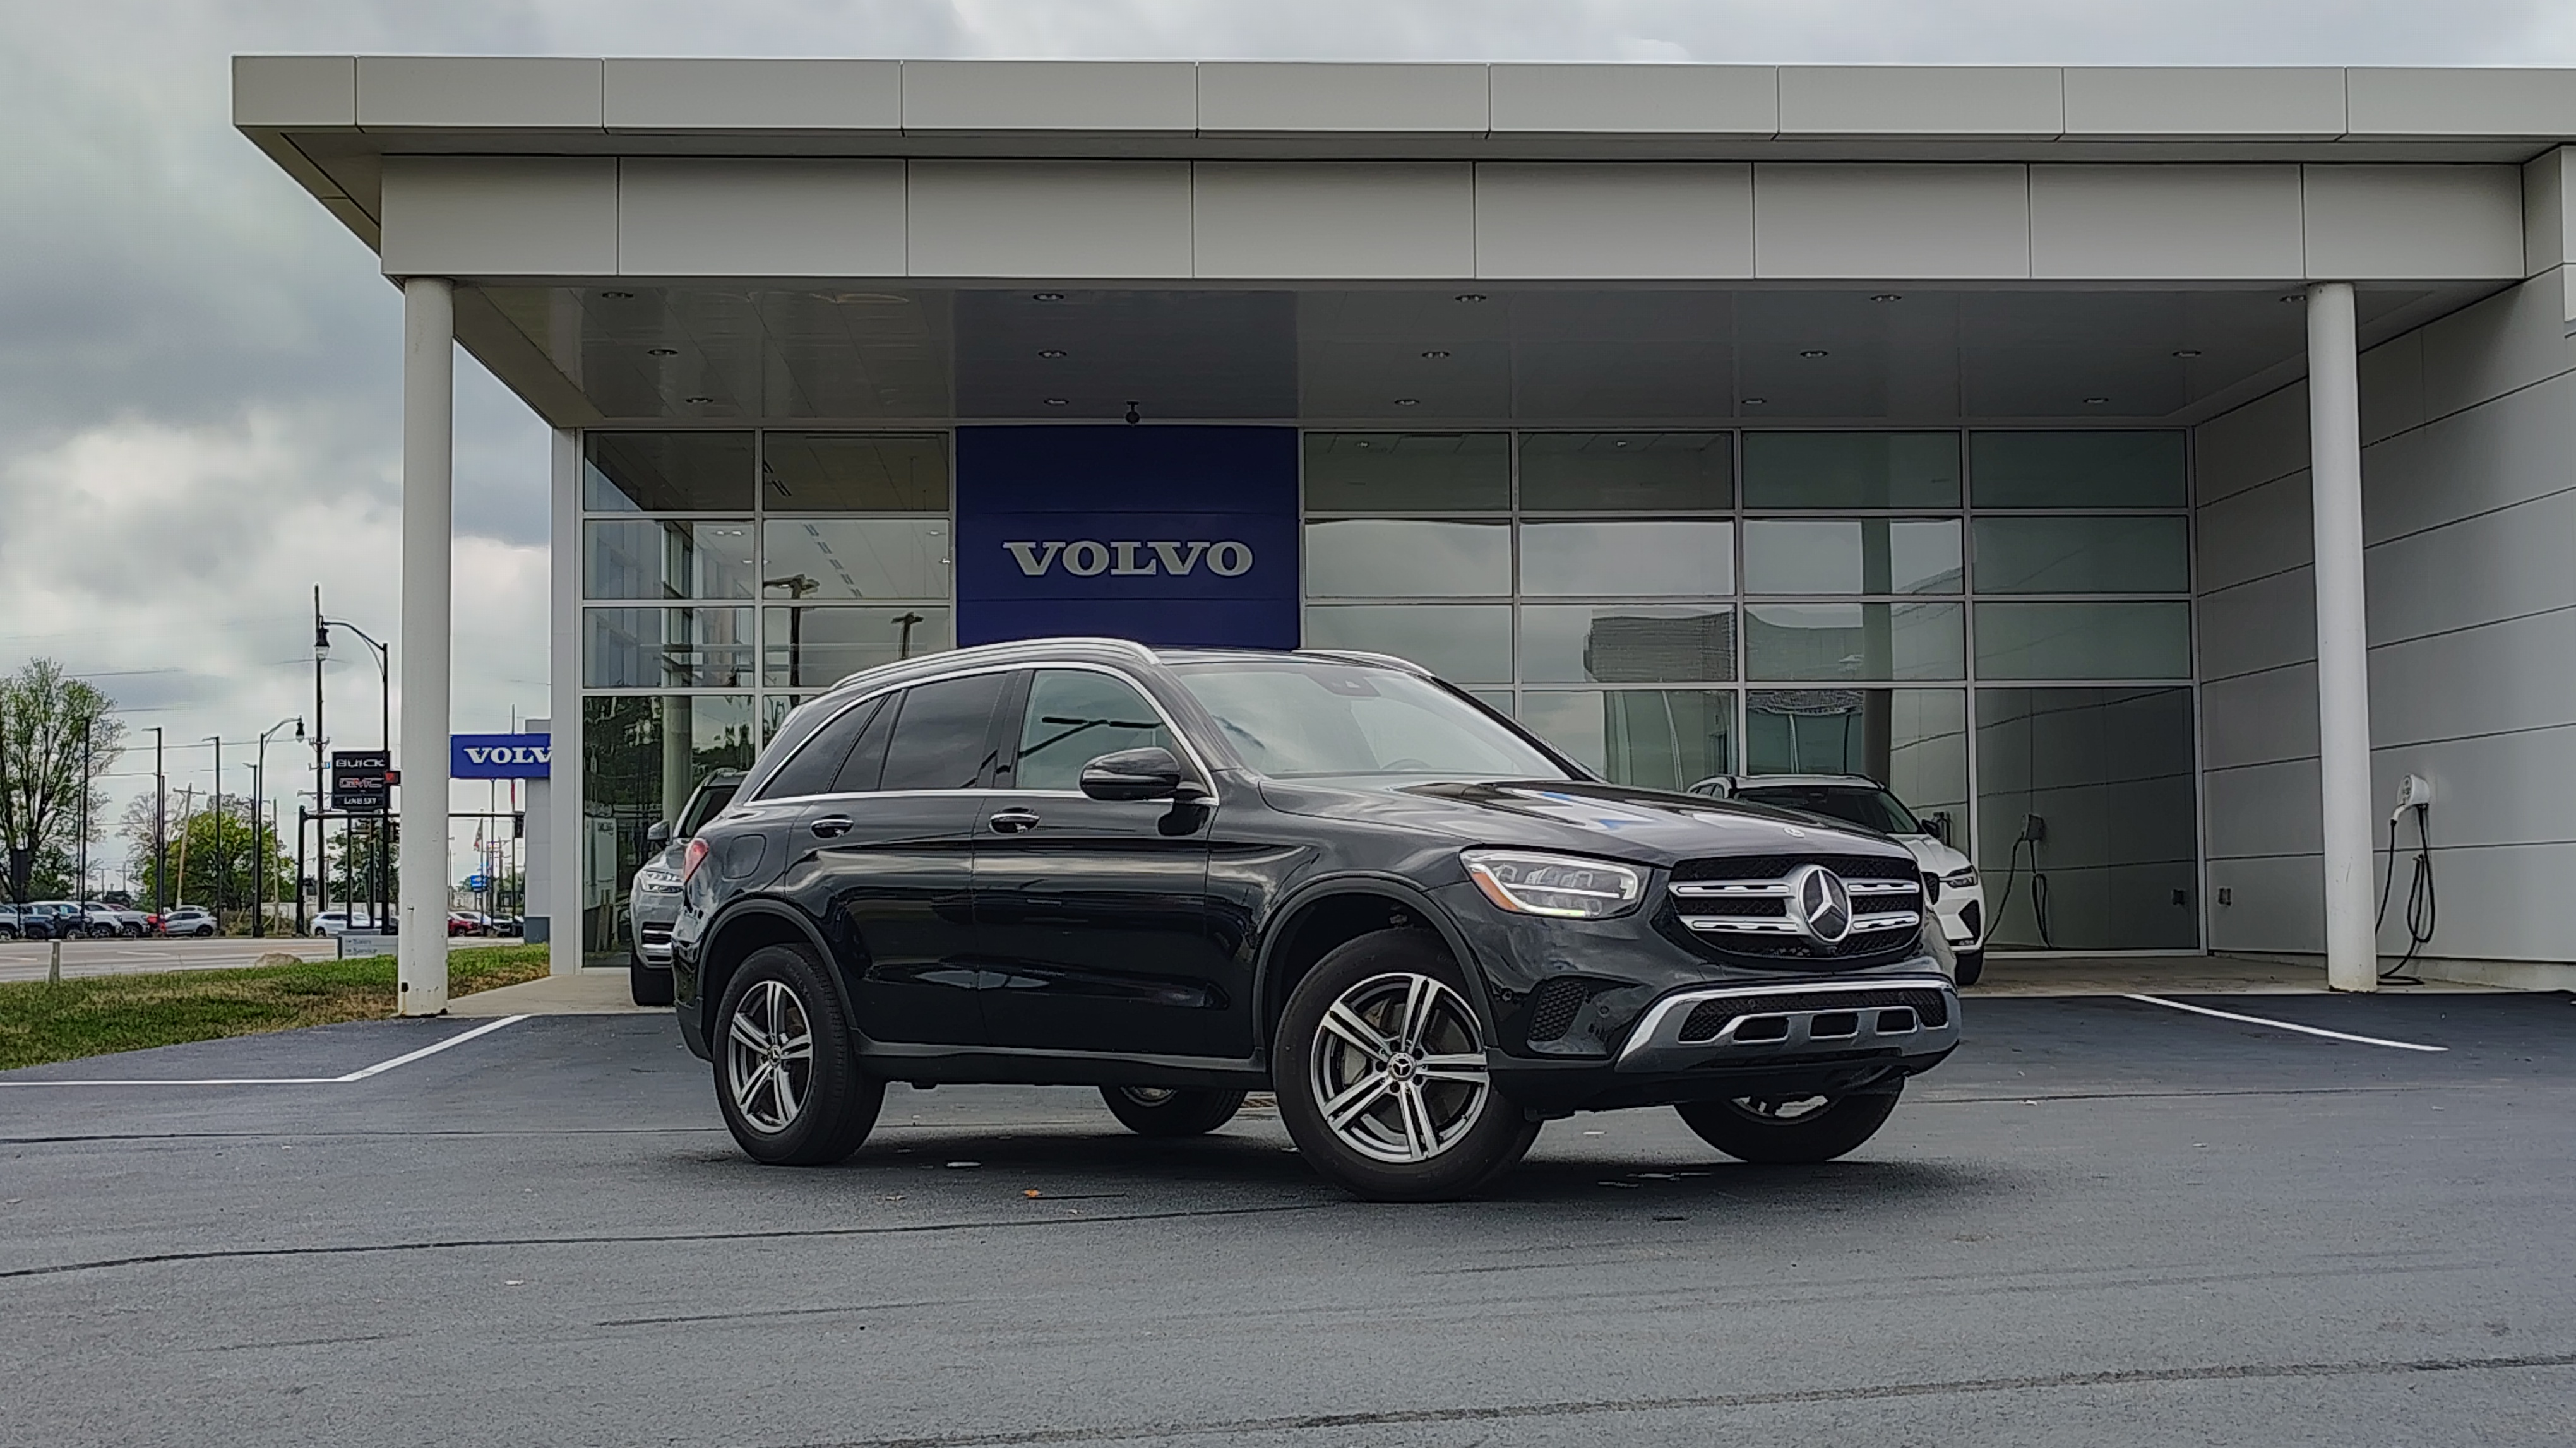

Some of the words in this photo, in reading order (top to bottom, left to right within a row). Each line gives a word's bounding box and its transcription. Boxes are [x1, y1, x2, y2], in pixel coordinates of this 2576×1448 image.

[1003, 540, 1253, 577] VOLVO
[463, 747, 552, 764] VOLV
[335, 759, 386, 768] BUICK
[339, 778, 383, 788] GMC
